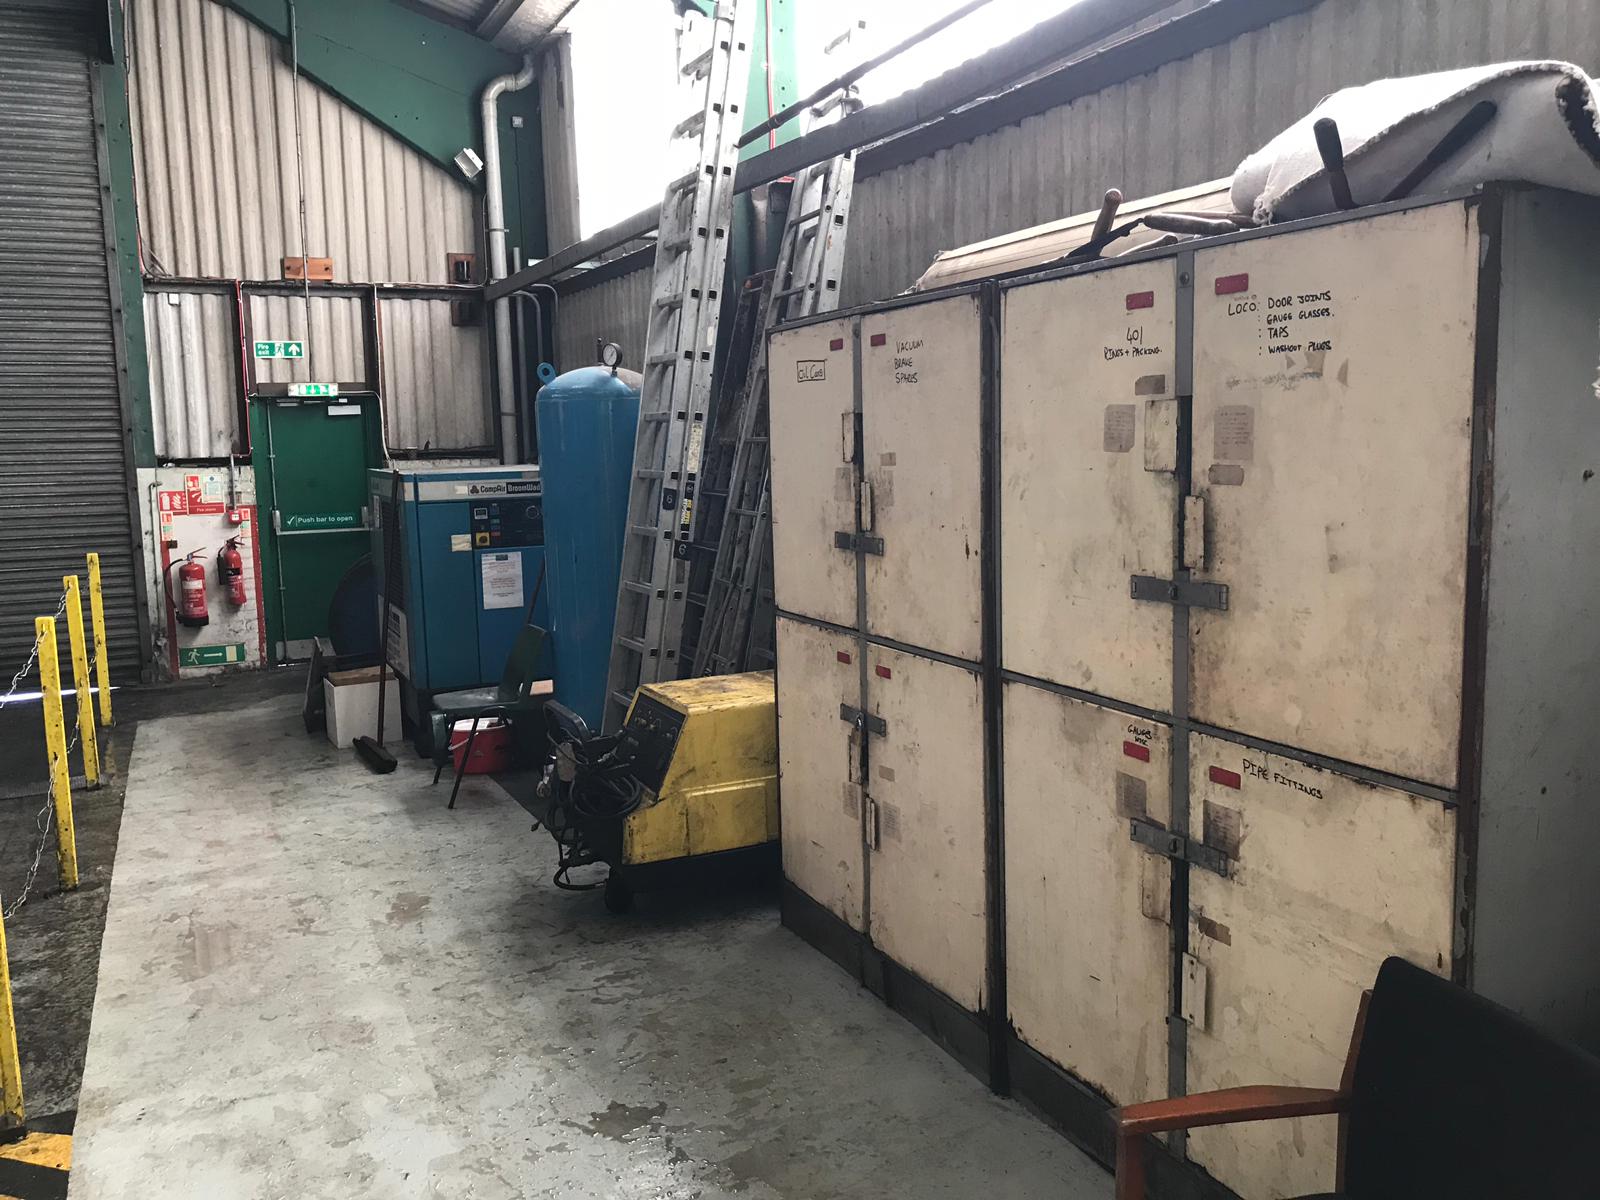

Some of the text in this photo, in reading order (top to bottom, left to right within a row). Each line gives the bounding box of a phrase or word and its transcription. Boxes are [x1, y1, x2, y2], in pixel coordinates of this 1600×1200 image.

[1267, 296, 1293, 309] DOOR
[1297, 290, 1332, 304] JOINTS
[1266, 313, 1293, 325] GAUGE
[1126, 325, 1143, 345] 401
[1267, 326, 1289, 339] TAPS
[896, 339, 924, 354] VACUUM
[1268, 344, 1302, 355] WASHOUT
[1307, 340, 1332, 352] PLUGS
[894, 357, 913, 370] BRAKE
[480, 482, 541, 494] CompAir BroomWad
[1242, 758, 1323, 800] PIPE FITTINGS
